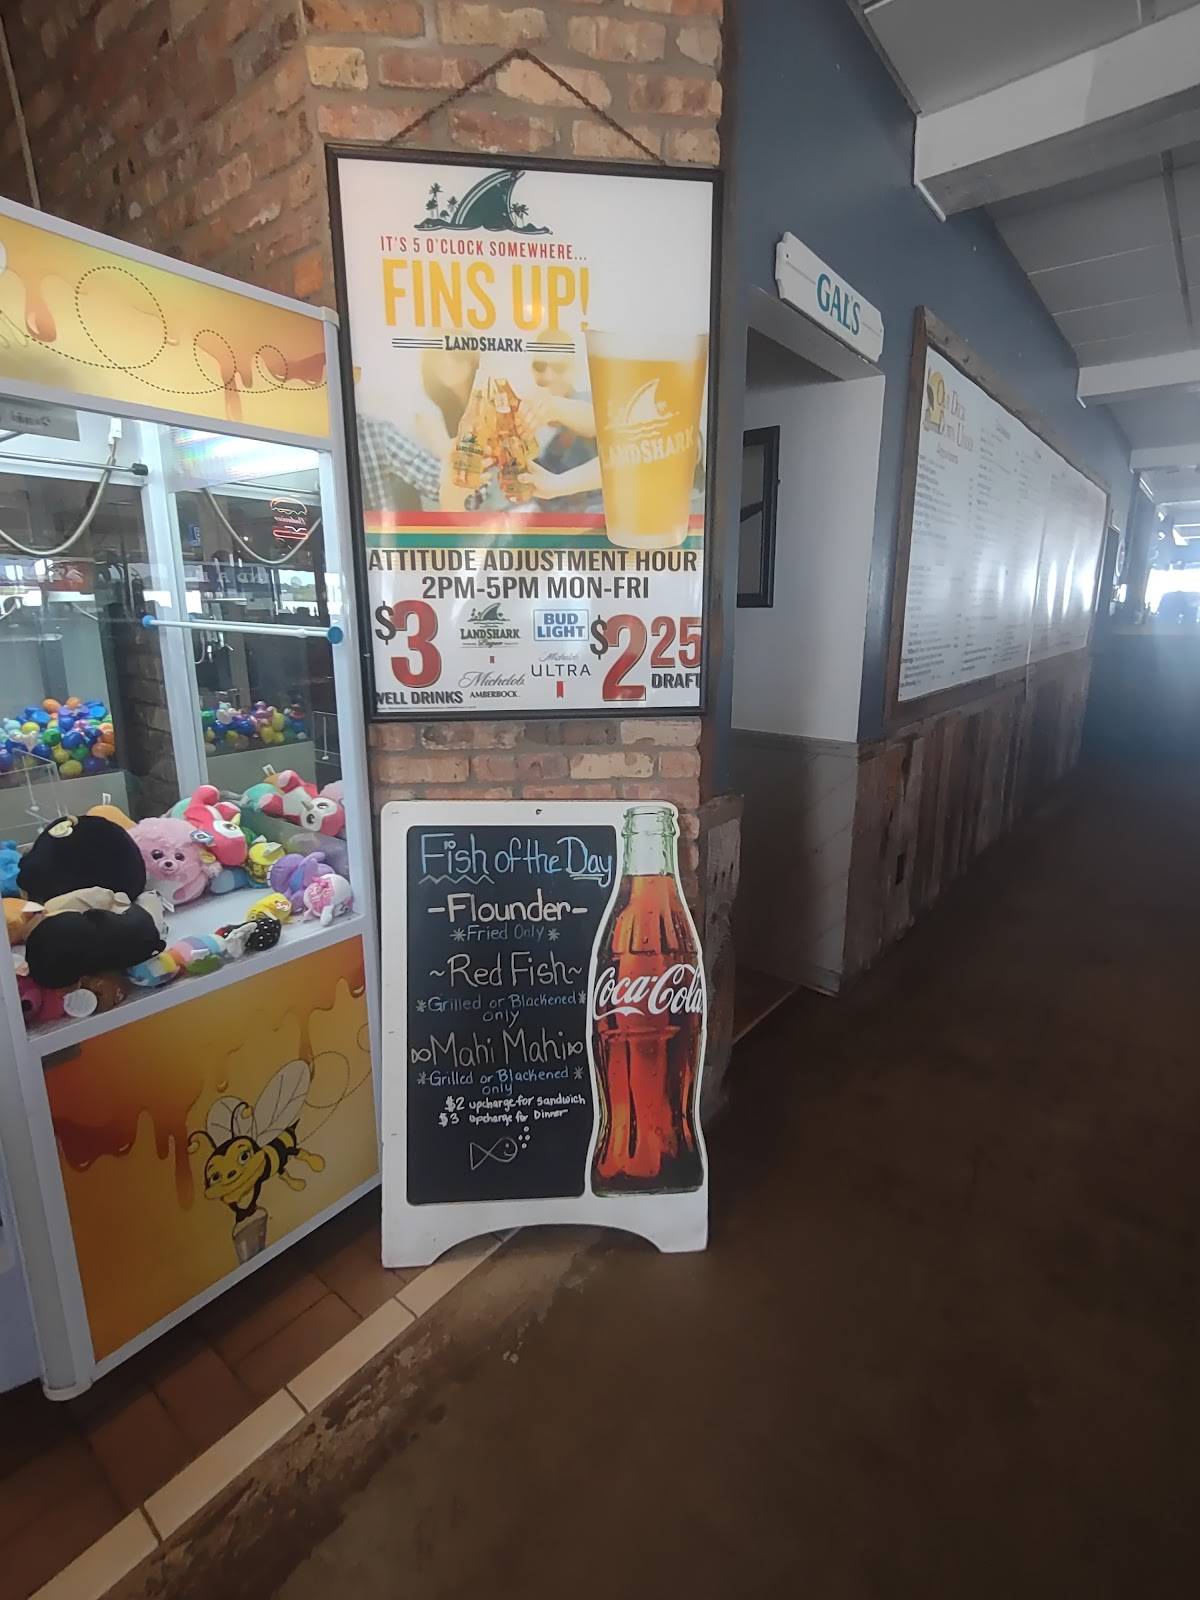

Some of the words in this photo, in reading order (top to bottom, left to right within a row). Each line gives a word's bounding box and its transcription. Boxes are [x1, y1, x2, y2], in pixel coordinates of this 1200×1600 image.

[380, 235, 407, 252] IT'S
[413, 239, 421, 253] 5
[426, 238, 485, 256] O'CLOCK
[382, 258, 497, 330] FINS
[511, 263, 590, 332] UP!
[816, 272, 861, 336] GAL'S
[445, 335, 524, 353] LANDSHARK
[368, 549, 477, 572] ATTITUDE
[483, 549, 629, 572] ADJUSTMENT
[635, 549, 698, 572] HOUR
[422, 575, 539, 600] 2PM-5PM
[547, 575, 650, 600] MON-FRI
[543, 612, 579, 625] BUD
[460, 628, 521, 640] LANDSHARK
[537, 625, 586, 638] LIGHT
[374, 599, 442, 689] $3
[457, 670, 526, 689] Michelob
[531, 663, 592, 678] ULTRA
[411, 690, 464, 705] DRINKS
[469, 690, 519, 699] AMBERBOCK
[420, 832, 490, 875] Fish
[494, 837, 521, 873] of
[522, 838, 562, 874] the
[557, 836, 613, 888] Day
[466, 924, 508, 942] Fried
[514, 924, 546, 942] Only
[427, 994, 482, 1013] Grilled
[488, 998, 501, 1009] or
[507, 990, 577, 1009] Blackened
[592, 963, 704, 1020] Coca-Cola
[482, 1009, 520, 1028] only
[430, 1031, 496, 1068] Mahi
[502, 1027, 567, 1065] Mahi
[429, 1070, 474, 1087] Grilled
[479, 1074, 493, 1084] or
[496, 1065, 570, 1084] Blackened
[481, 1083, 514, 1096] only
[444, 1095, 466, 1113] $2
[468, 1096, 516, 1113] upcharge
[516, 1095, 535, 1107] for
[536, 1092, 587, 1107] sandwich
[438, 1112, 461, 1127] $3
[514, 1110, 530, 1124] for
